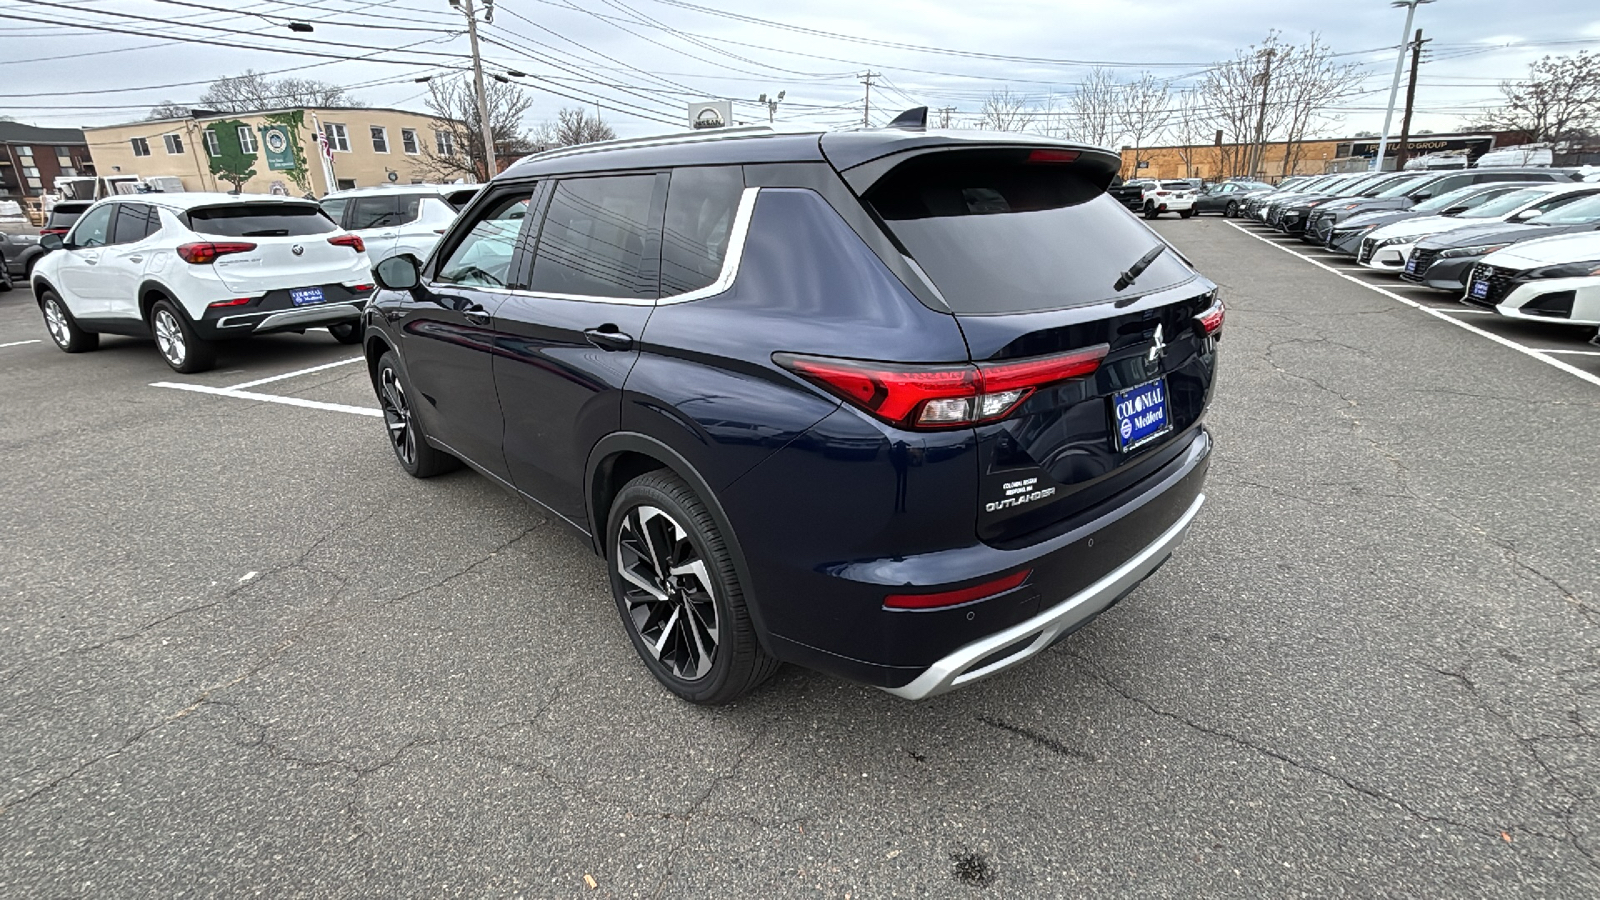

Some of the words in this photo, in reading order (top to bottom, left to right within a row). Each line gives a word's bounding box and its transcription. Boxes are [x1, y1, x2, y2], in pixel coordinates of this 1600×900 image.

[1369, 143, 1415, 151] POTLAD
[1416, 141, 1448, 149] GROUP
[1116, 387, 1164, 420] COLONIAL
[1134, 406, 1163, 431] Medford
[985, 486, 1056, 513] OUTLANDER
